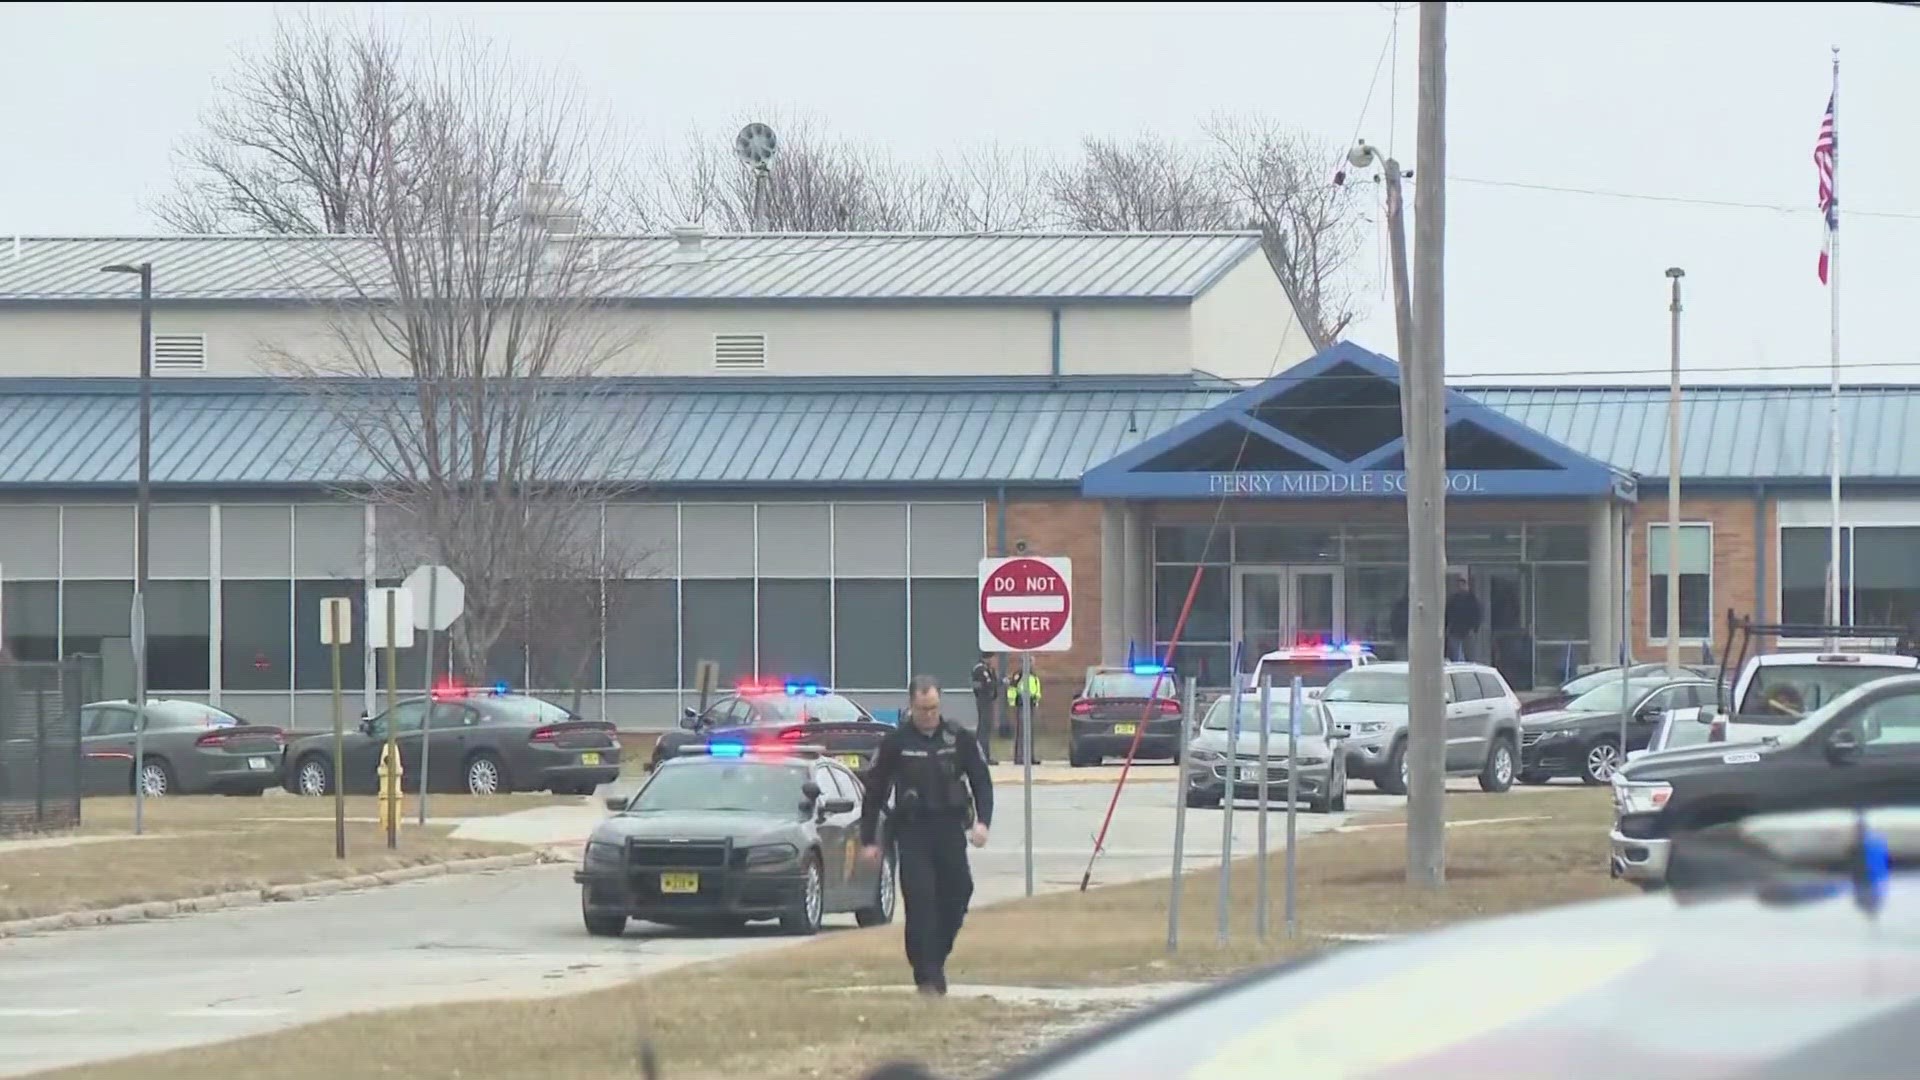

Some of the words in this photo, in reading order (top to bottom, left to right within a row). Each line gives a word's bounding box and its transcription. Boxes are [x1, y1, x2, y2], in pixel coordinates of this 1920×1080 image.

[1209, 474, 1275, 493] PERRY
[1281, 474, 1374, 493] MIDDLE
[1382, 473, 1485, 492] SCOL
[994, 576, 1016, 592] DO
[1026, 576, 1057, 592] NOT
[1000, 616, 1051, 632] ENTER
